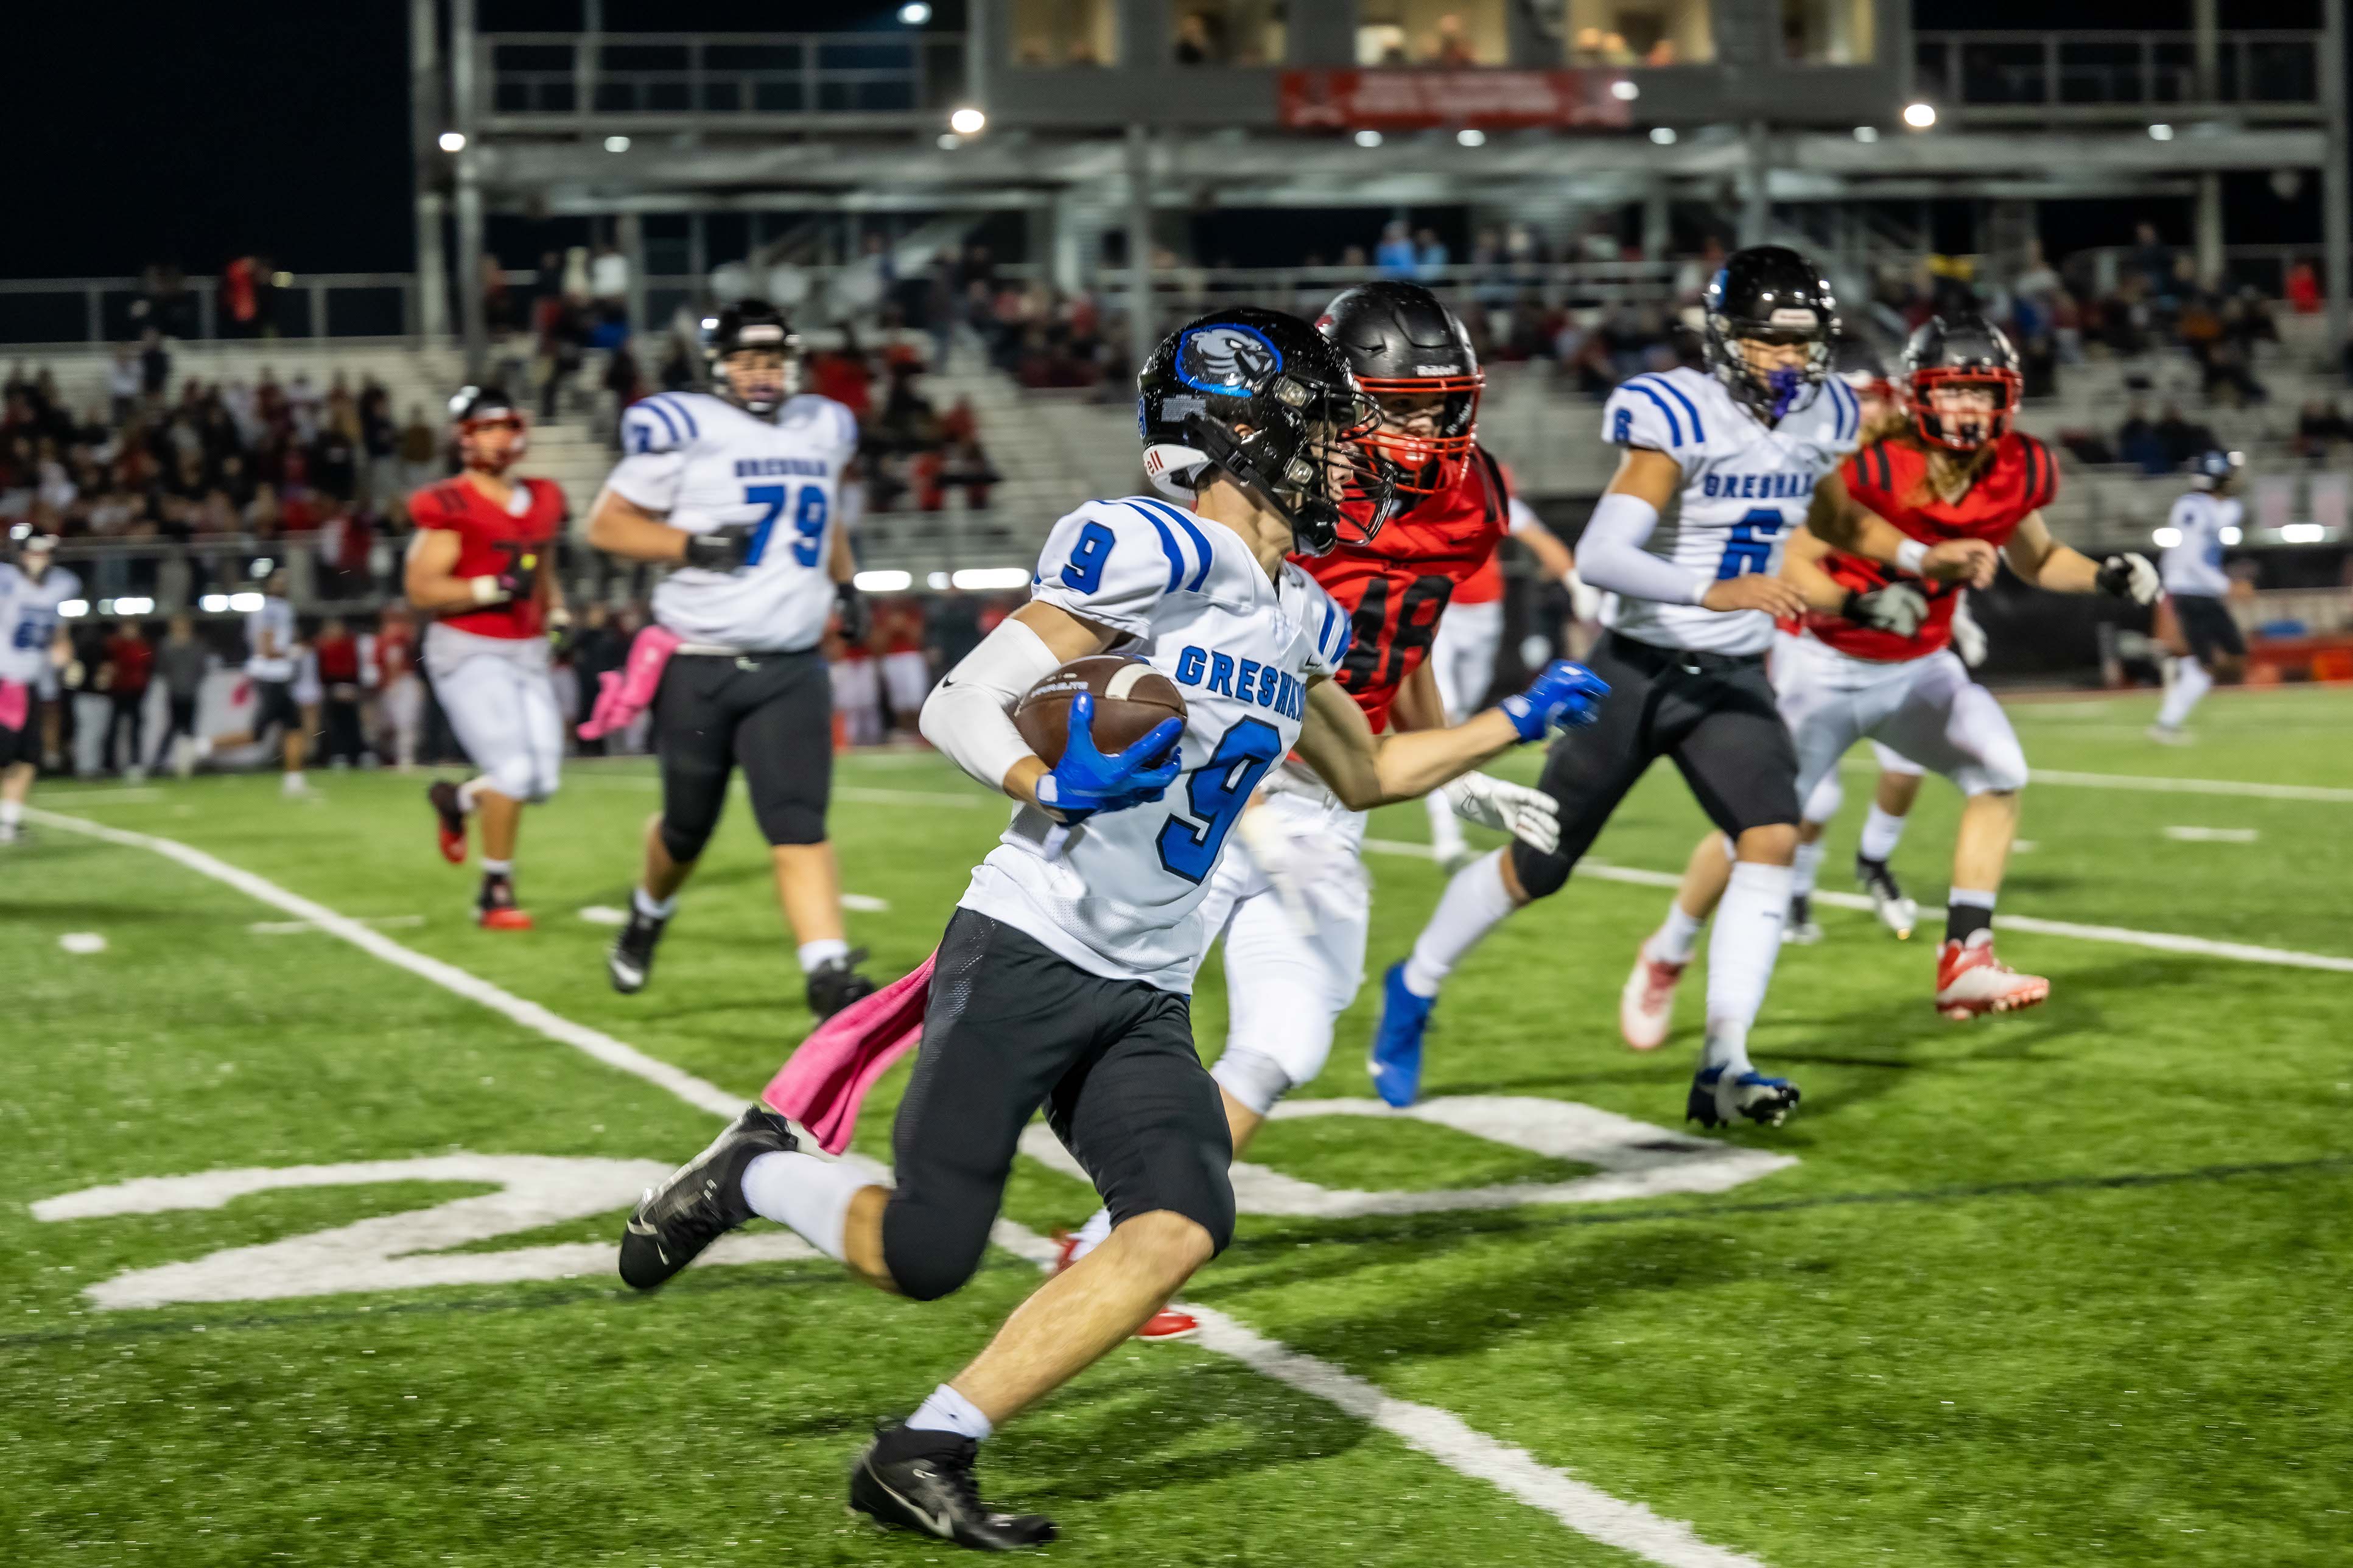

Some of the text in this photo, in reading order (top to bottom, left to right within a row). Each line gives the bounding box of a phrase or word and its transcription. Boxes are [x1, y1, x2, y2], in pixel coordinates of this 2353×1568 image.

[744, 485, 827, 567] 79
[1061, 519, 1116, 595] 9
[1717, 509, 1783, 580] 6
[1157, 714, 1282, 885] 9
